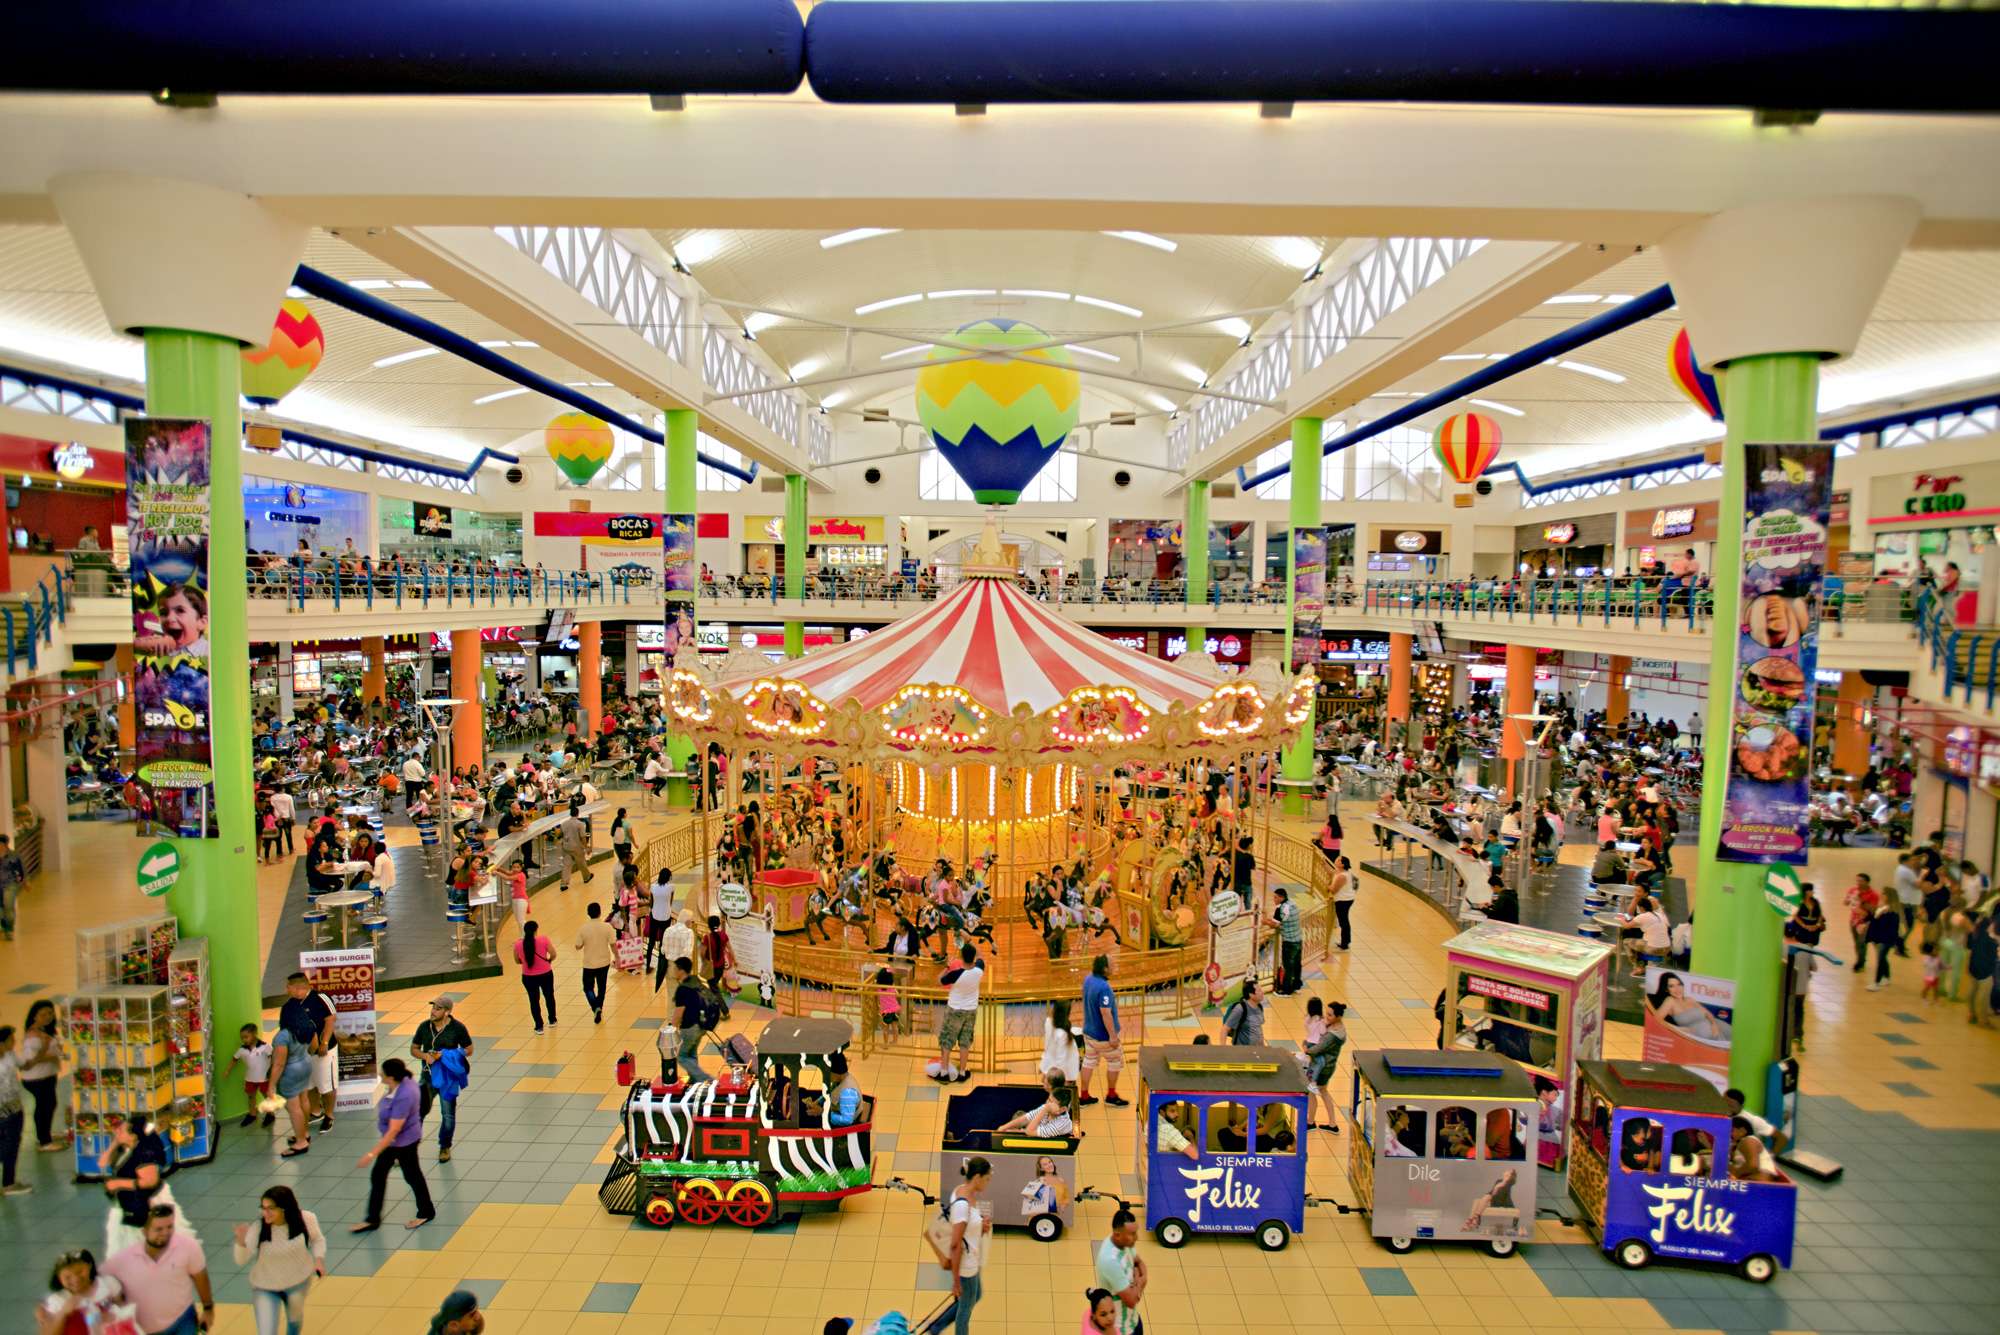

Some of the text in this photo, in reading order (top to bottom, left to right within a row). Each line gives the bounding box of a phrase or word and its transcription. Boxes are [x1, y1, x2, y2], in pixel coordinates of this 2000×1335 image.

[145, 513, 170, 528] HOT
[174, 515, 202, 528] DOG
[611, 520, 649, 530] BOCAS
[612, 568, 652, 578] BOCAS
[145, 712, 205, 728] SPACE
[149, 764, 209, 772] ALBROOK MALL
[164, 780, 203, 788] KANGURO
[145, 875, 175, 893] SALIDA
[319, 983, 347, 991] PARTY
[1509, 985, 1547, 1001] BOLETOS
[331, 993, 373, 1004] $22.95
[1103, 996, 1110, 1006] 3
[1470, 983, 1490, 993] PARA
[1503, 992, 1546, 1008] CARRUSEL
[337, 1098, 370, 1107] BURGER
[1216, 1156, 1273, 1168] SIEMPRE
[1408, 1163, 1441, 1181] Dile
[1684, 1176, 1749, 1192] SIEMPRE
[1178, 1164, 1261, 1223] Felix
[1642, 1183, 1735, 1243] Felix
[1659, 1244, 1686, 1253] PASILLO
[1701, 1249, 1725, 1257] KOALA
